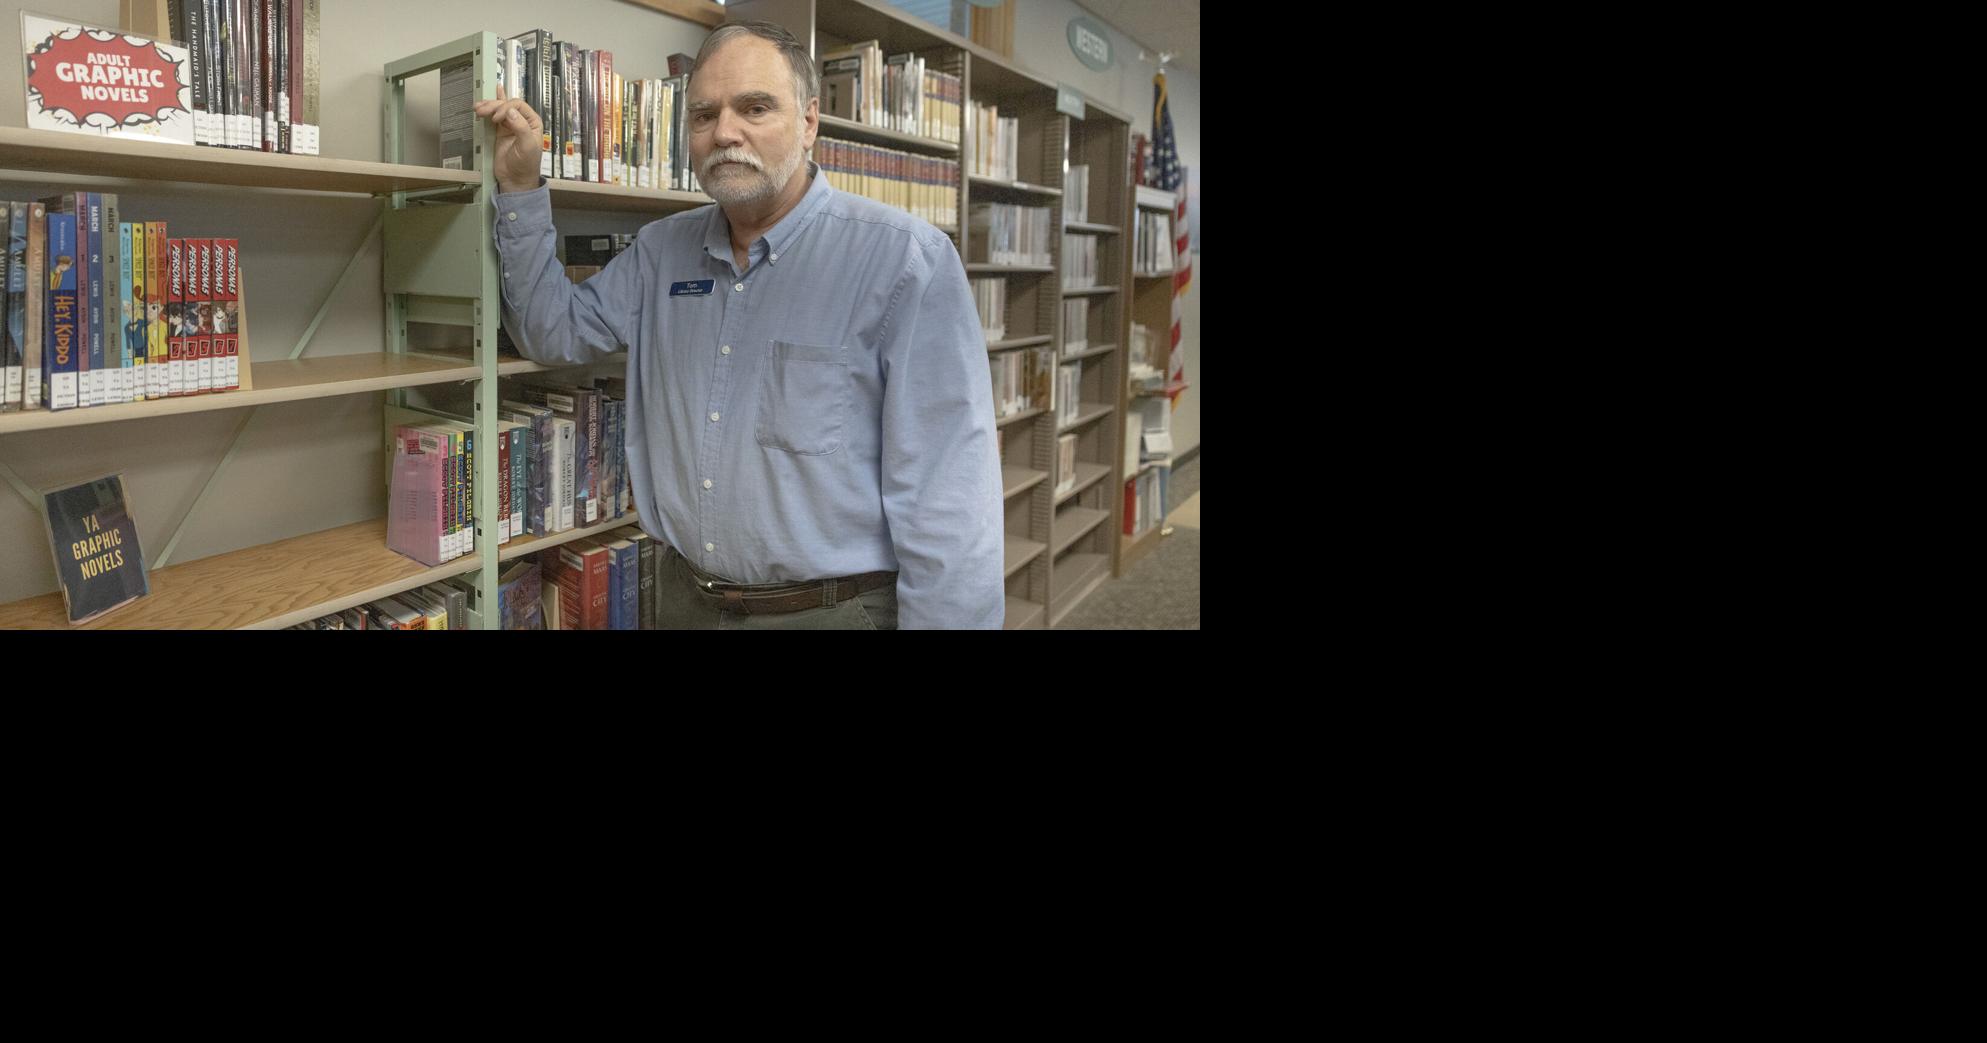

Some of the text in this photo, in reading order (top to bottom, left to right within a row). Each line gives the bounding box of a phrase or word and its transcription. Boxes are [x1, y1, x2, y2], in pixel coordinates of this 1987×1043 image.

[87, 52, 131, 67] ADULT
[191, 29, 200, 78] HANDMAID'S
[55, 62, 165, 88] GRAPHIC
[80, 85, 149, 104] NOVELS
[107, 207, 115, 233] MARCH
[92, 254, 98, 263] 2
[109, 255, 114, 263] 3
[53, 324, 74, 365] KIDDO
[82, 514, 100, 534] YA
[72, 528, 122, 560] GRAPHIC
[80, 549, 124, 580] NOVELS
